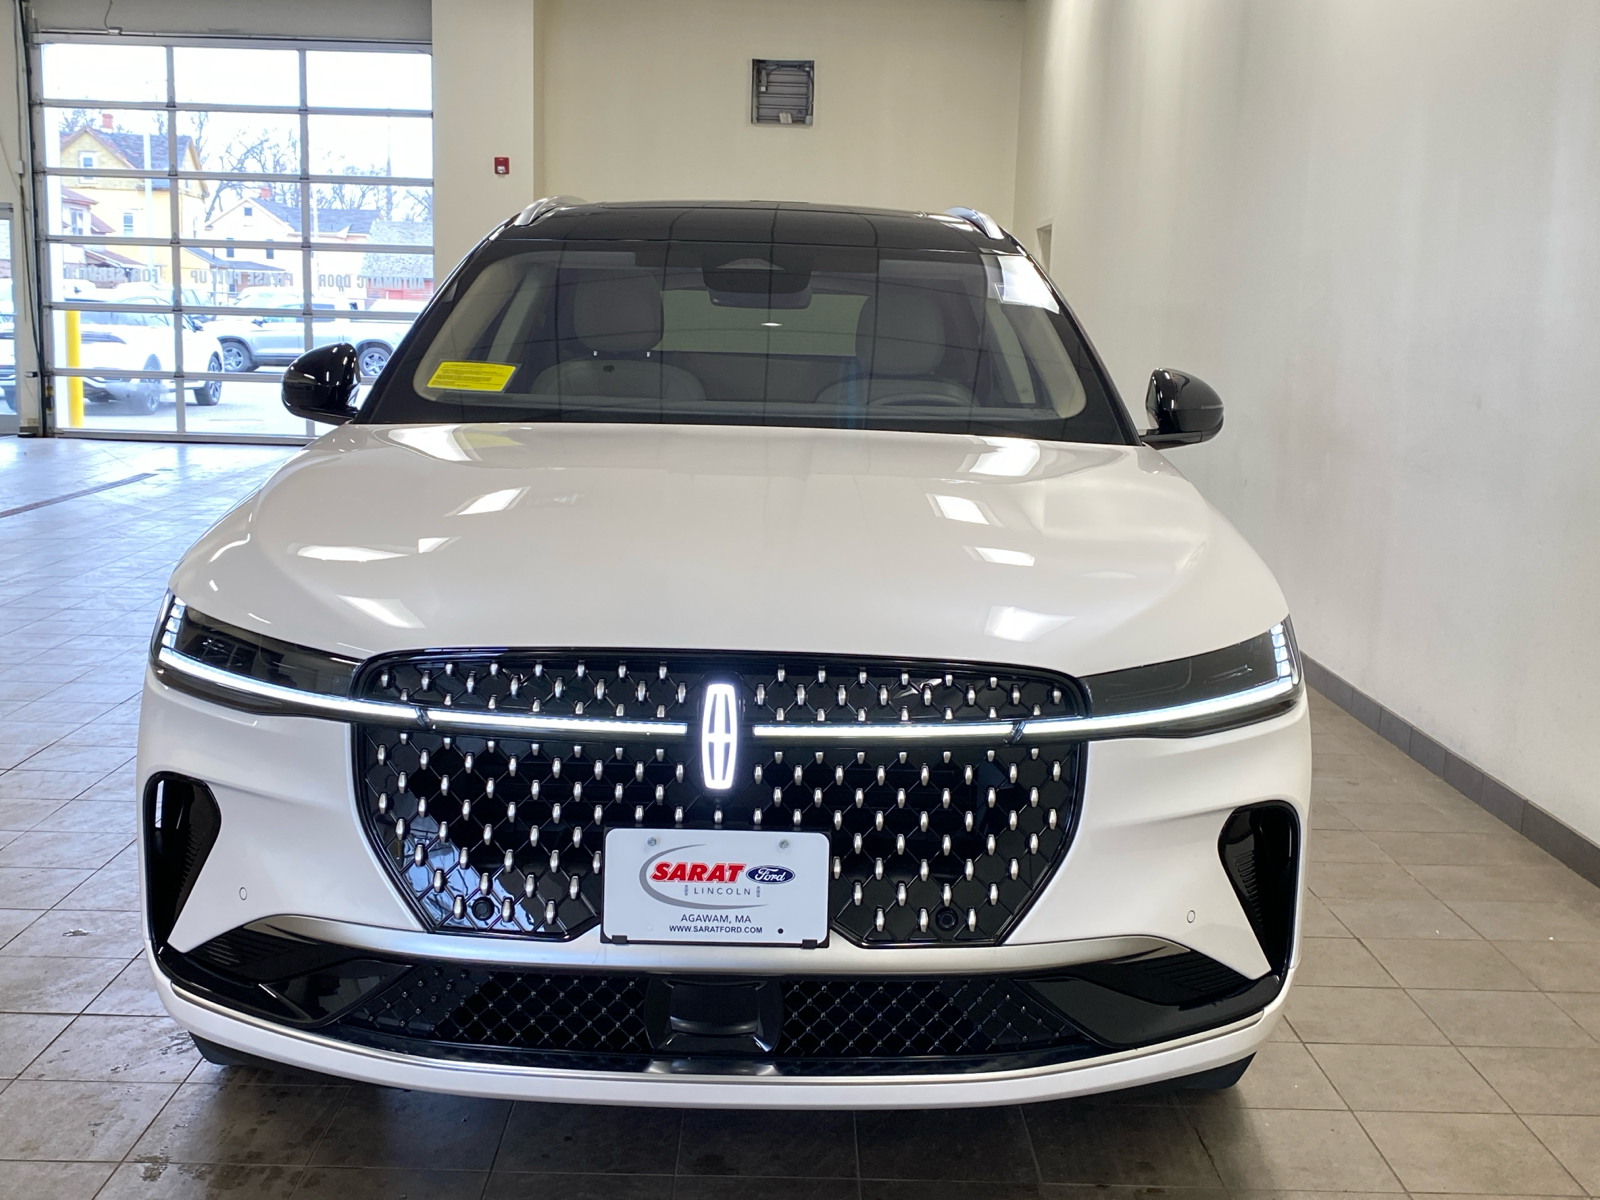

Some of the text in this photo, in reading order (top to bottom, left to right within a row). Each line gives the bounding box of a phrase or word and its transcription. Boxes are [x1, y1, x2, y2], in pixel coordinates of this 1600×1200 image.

[649, 861, 786, 884] SARAT Ford
[693, 887, 751, 896] LINCOLN
[680, 914, 752, 924] AGAWAM, MA
[669, 925, 763, 934] WWW.SARATFORD.COM
